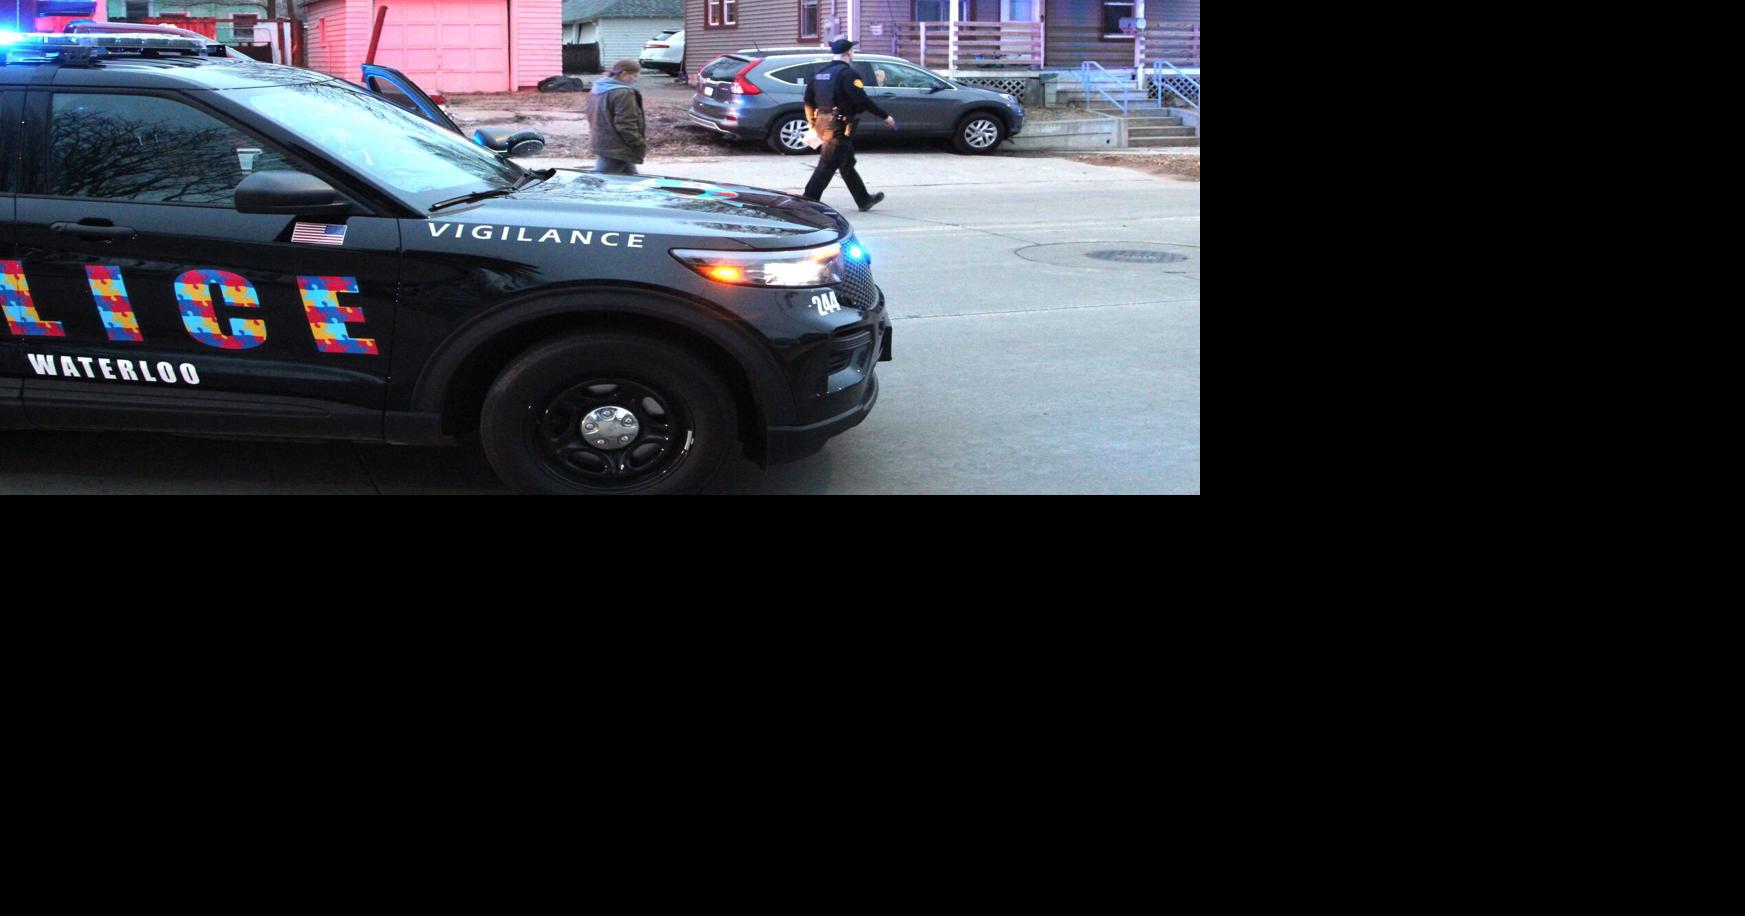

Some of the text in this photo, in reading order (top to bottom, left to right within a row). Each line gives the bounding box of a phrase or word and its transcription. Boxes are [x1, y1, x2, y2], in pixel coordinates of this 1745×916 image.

[428, 222, 645, 248] VIGILANCE
[811, 290, 841, 316] 244
[27, 353, 200, 385] WATERLOO
